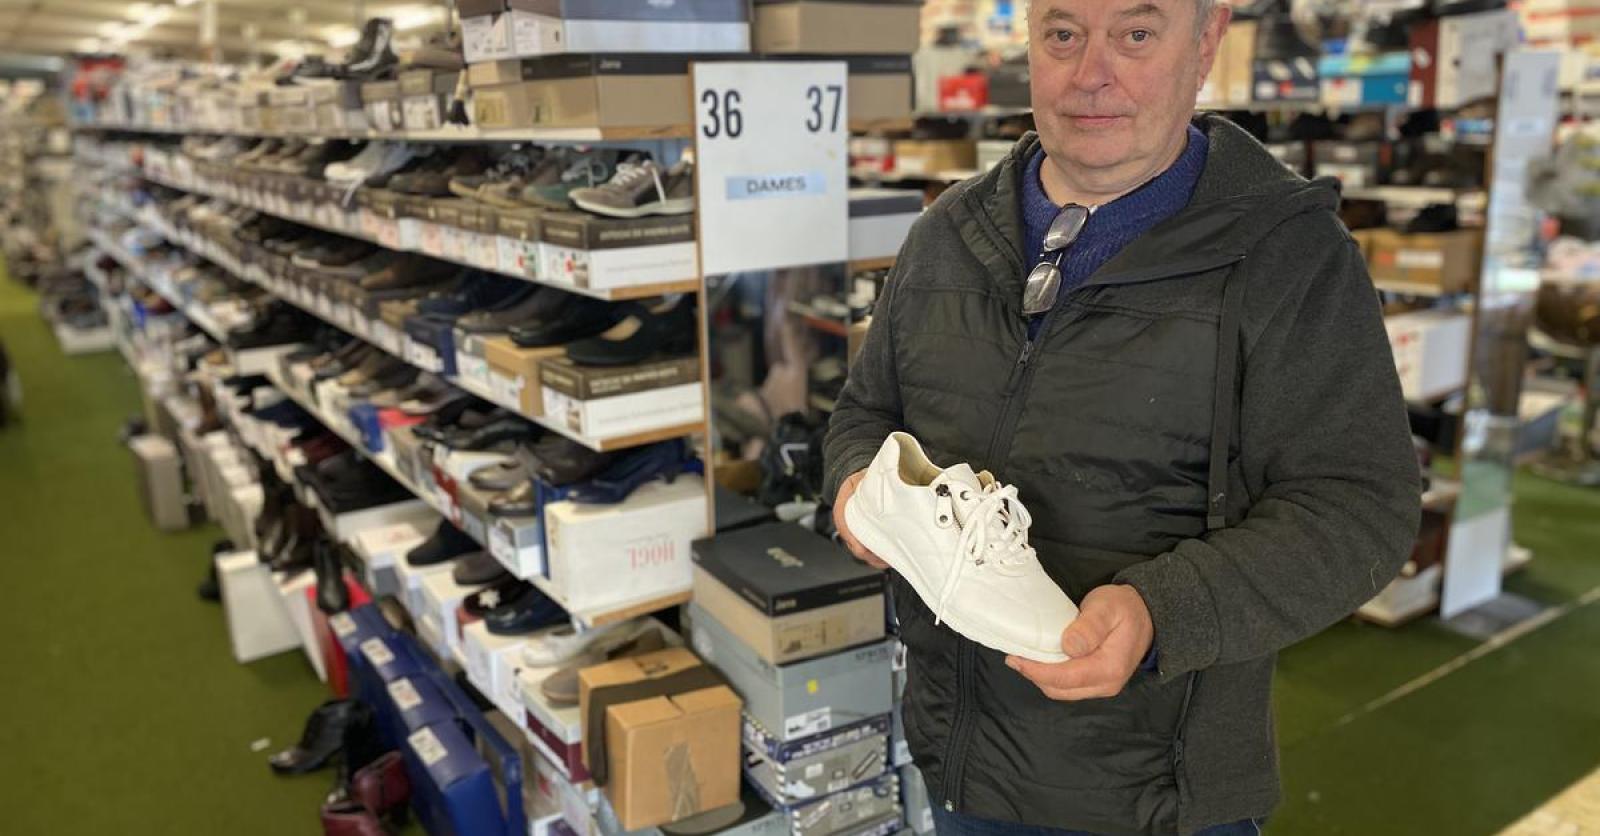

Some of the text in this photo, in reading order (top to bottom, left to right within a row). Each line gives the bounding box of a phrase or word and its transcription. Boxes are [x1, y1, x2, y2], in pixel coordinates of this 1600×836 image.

[702, 85, 842, 139] 36 37
[746, 176, 807, 194] DAMES
